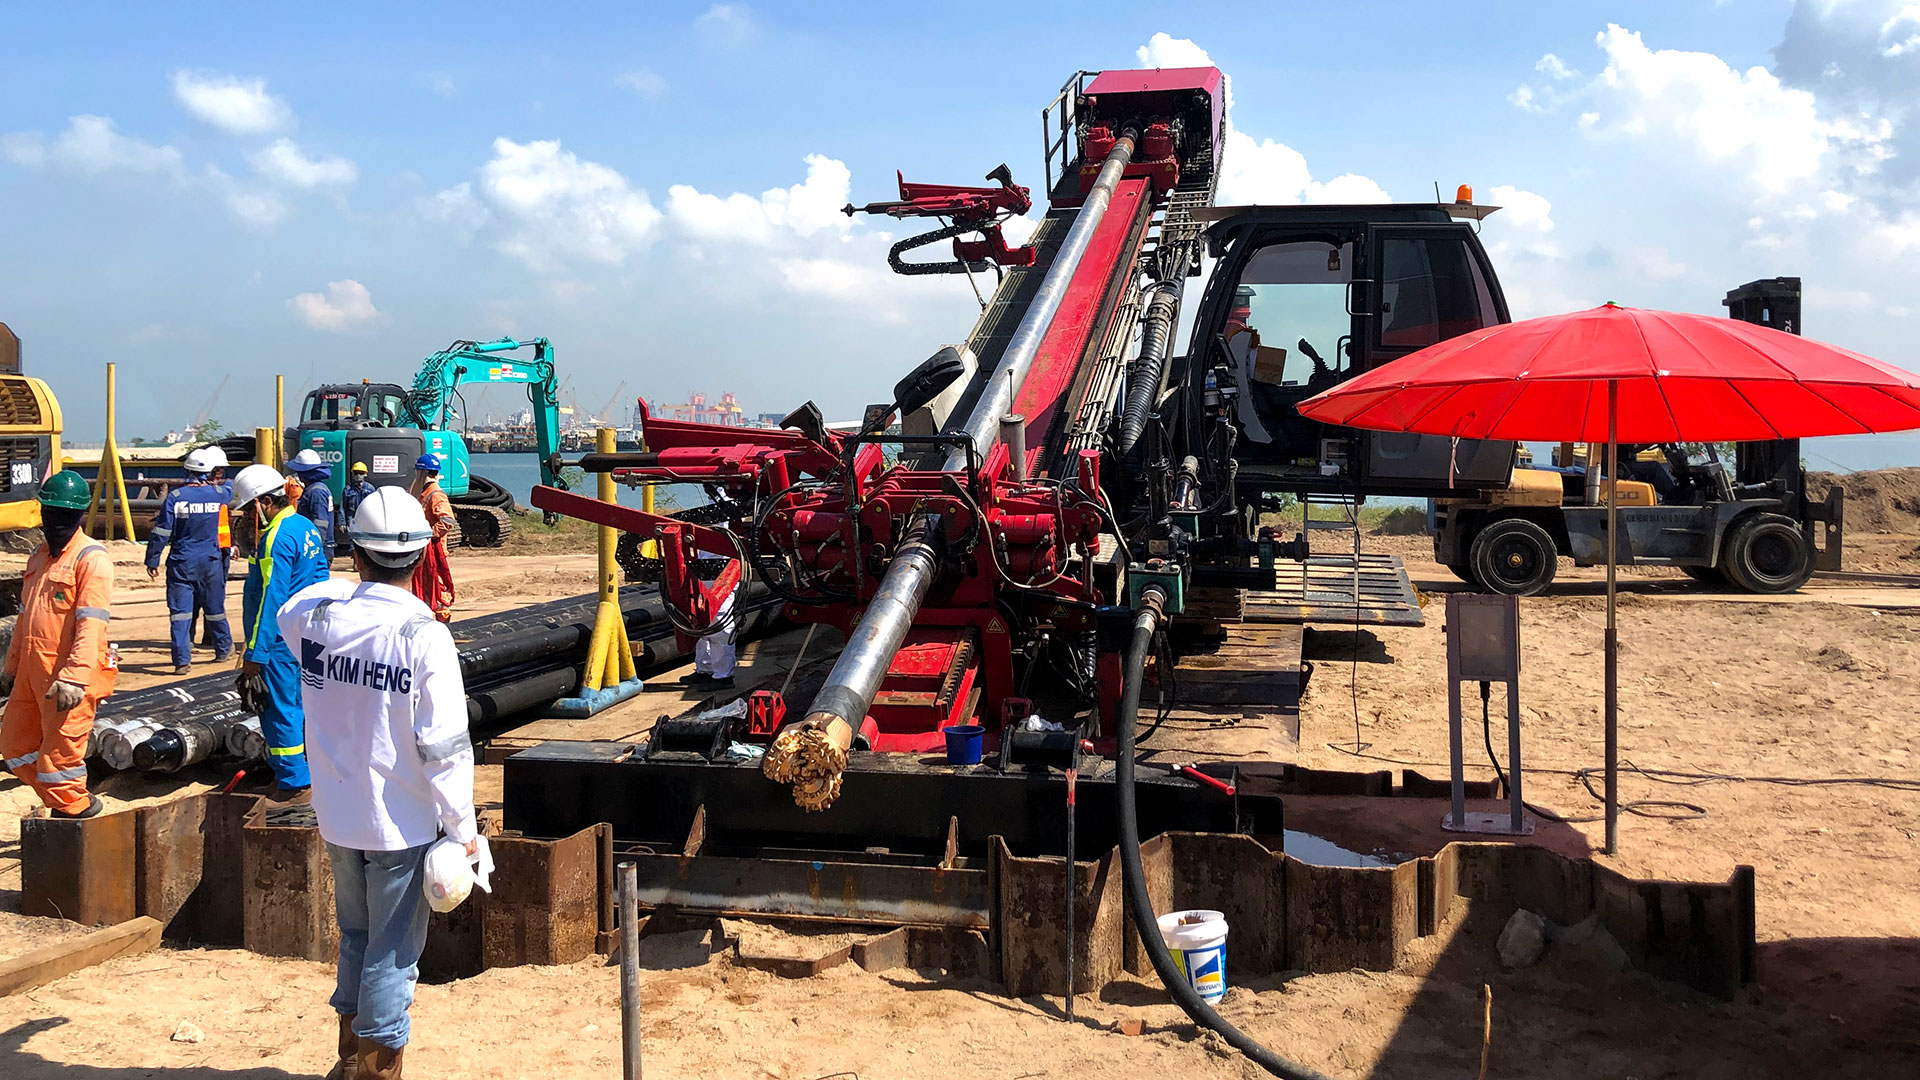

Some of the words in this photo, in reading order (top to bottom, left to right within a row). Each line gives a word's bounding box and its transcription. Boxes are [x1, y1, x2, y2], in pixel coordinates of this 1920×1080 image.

[204, 502, 220, 513] HEN
[327, 653, 360, 685] KIM
[363, 660, 412, 694] HENG
